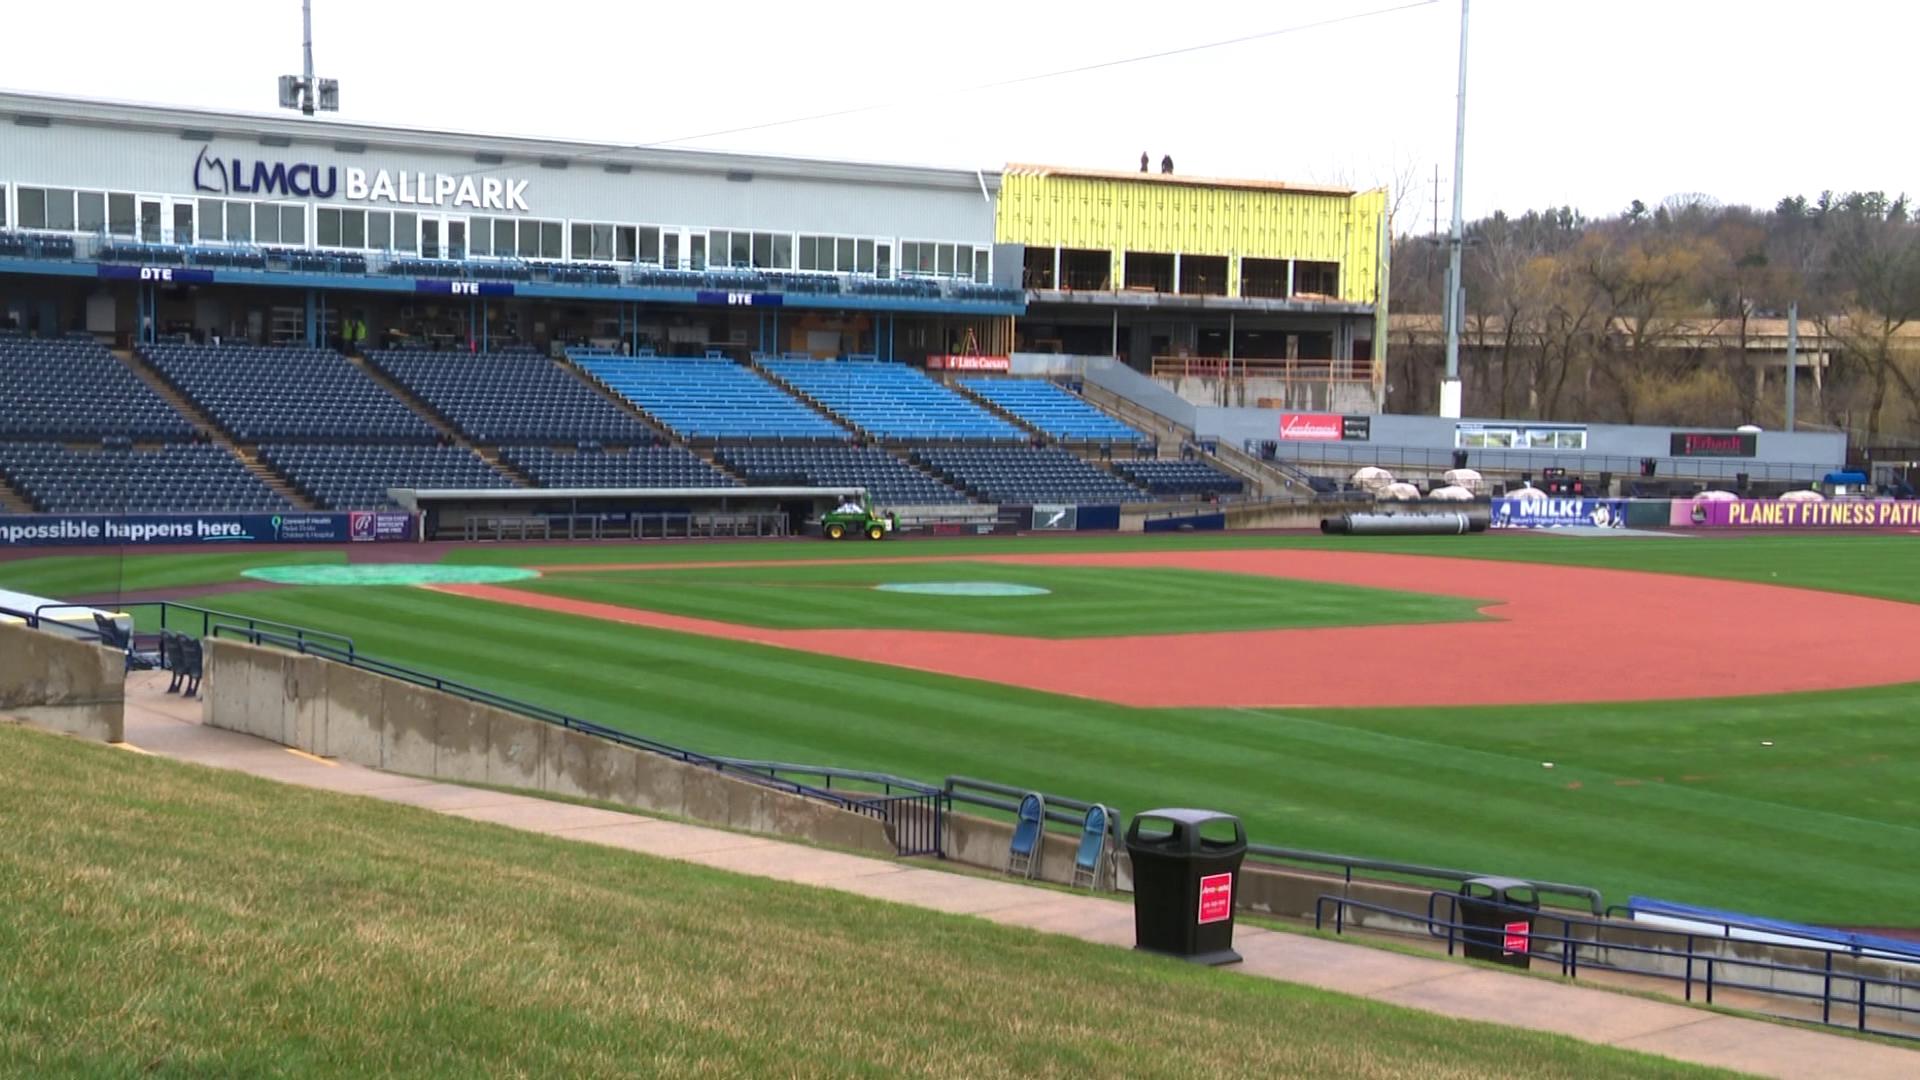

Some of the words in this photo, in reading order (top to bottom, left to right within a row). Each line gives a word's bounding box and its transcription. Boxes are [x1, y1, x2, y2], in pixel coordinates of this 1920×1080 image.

[232, 158, 337, 199] LMCU
[346, 167, 529, 212] BALLPARK
[141, 267, 172, 280] DTE
[451, 282, 479, 295] DTE
[727, 292, 752, 305] DTE
[1519, 500, 1583, 517] MILK!
[1728, 503, 1797, 524] PLANET
[1802, 503, 1875, 524] FITNESS
[105, 520, 193, 541] happens
[197, 519, 247, 537] here.
